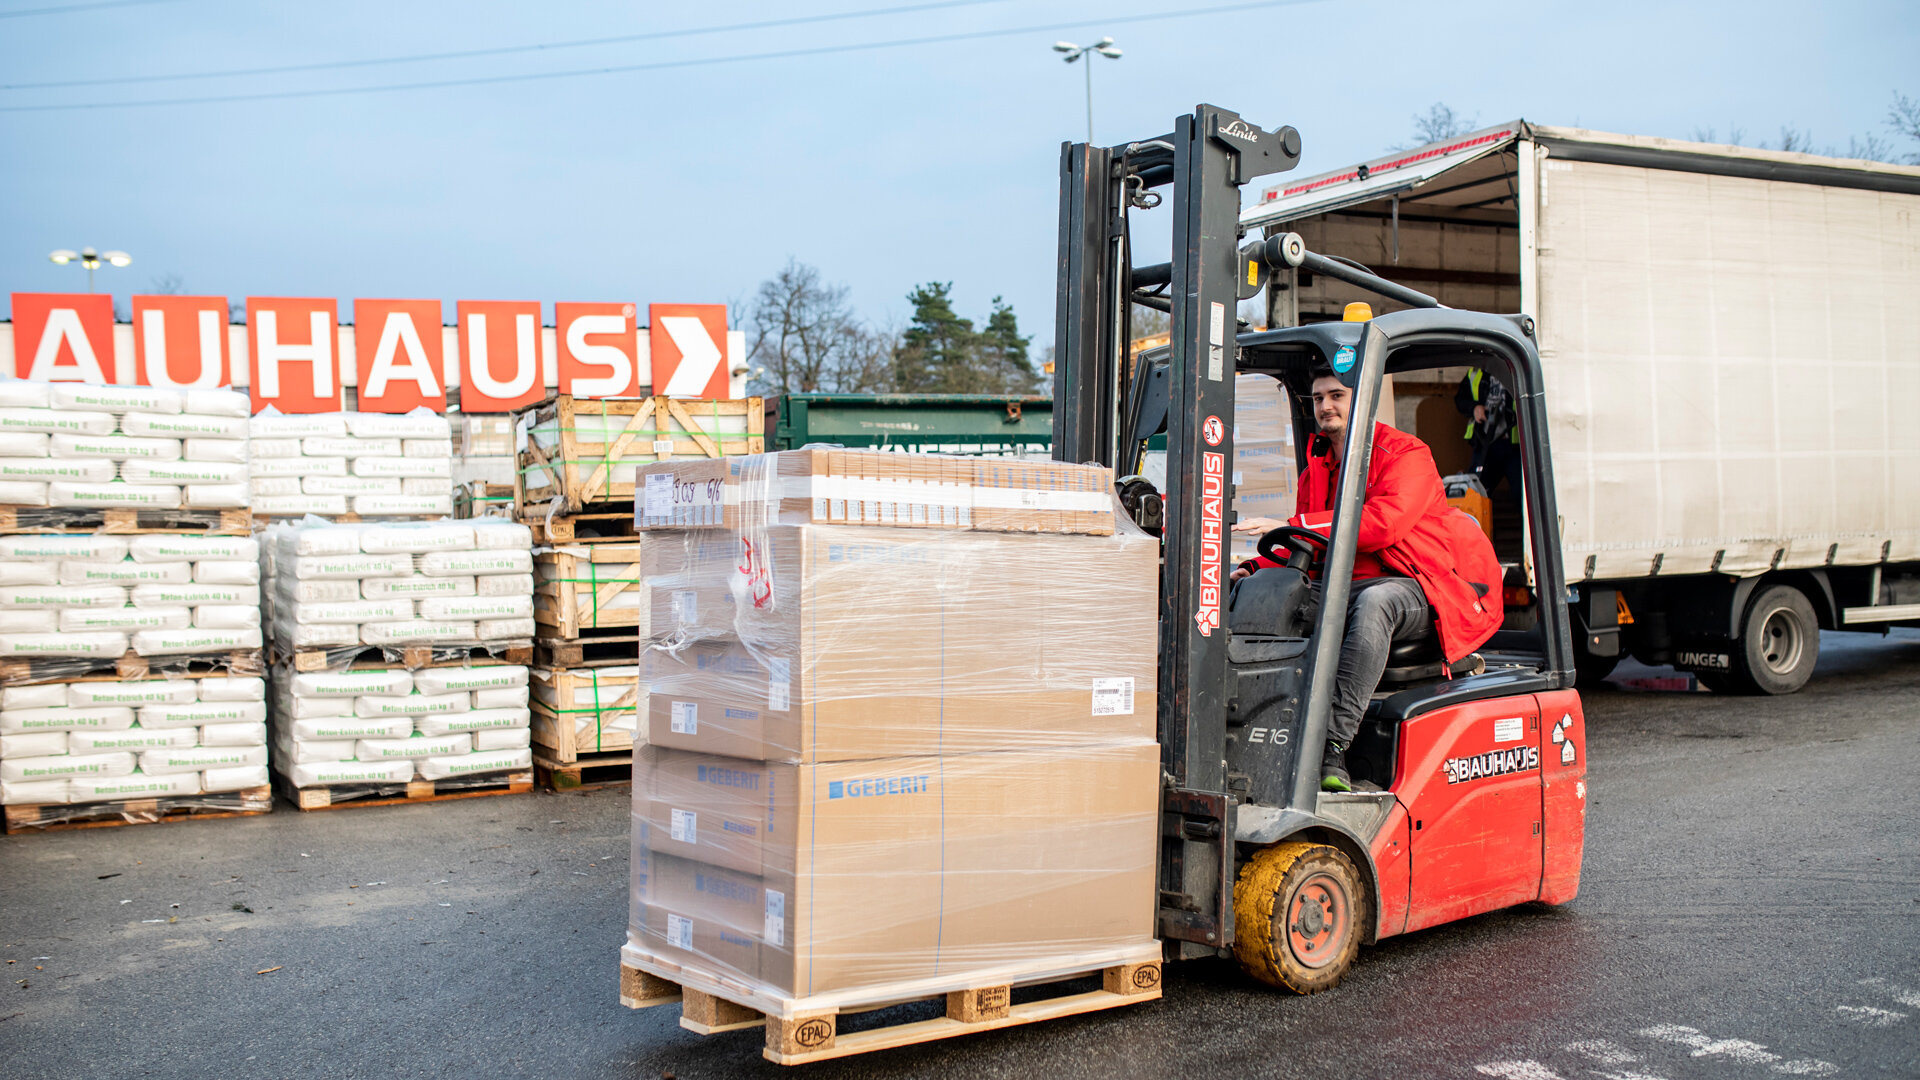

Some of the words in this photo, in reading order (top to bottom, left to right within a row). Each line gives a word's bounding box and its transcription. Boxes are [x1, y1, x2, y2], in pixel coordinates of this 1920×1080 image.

[1218, 120, 1258, 143] Linde
[76, 396, 126, 406] Beton-Estrich
[143, 400, 150, 408] kg
[2, 418, 55, 427] Beton-Estrich
[70, 421, 78, 429] kg
[149, 423, 198, 432] Beton-Estrich
[212, 426, 221, 434] kg
[75, 444, 125, 454] Beton-Estrich
[140, 448, 149, 456] kg
[3, 467, 55, 475] Beton-Estrich
[70, 469, 79, 477] kg
[150, 470, 198, 479] Beton-Estrich
[212, 473, 221, 481] kg
[74, 492, 125, 500] Beton-Estrich
[139, 494, 148, 502] kg
[1202, 455, 1223, 605] BAUHAUS
[81, 549, 90, 557] kg
[221, 548, 230, 556] kg
[86, 571, 137, 579] Beton-Estrich
[150, 571, 159, 579] kg
[15, 596, 68, 604] Beton-Estrich
[82, 597, 91, 605] kg
[161, 593, 210, 601] Beton-Estrich
[223, 593, 232, 601] kg
[150, 617, 158, 625] kg
[14, 644, 67, 652] Beton-Estrich
[82, 644, 91, 652] kg
[162, 639, 211, 648] Beton-Estrich
[224, 638, 233, 646] kg
[377, 685, 385, 693] kg
[446, 681, 490, 689] Beton-Estrich
[501, 678, 508, 686] kg
[92, 694, 143, 702] Beton-Estrich
[146, 693, 154, 701] 40
[156, 693, 165, 702] kg
[167, 713, 216, 721] Beton-Estrich
[218, 711, 226, 719] 40
[228, 711, 237, 720] kg
[22, 719, 74, 727] Beton-Estrich
[77, 718, 86, 726] 40
[89, 718, 98, 727] kg
[449, 721, 492, 730] Beton-Estrich
[494, 719, 502, 727] 40
[502, 719, 510, 727] kg
[377, 727, 385, 736] kg
[1247, 727, 1267, 743] E
[1269, 728, 1289, 745] 16
[93, 739, 143, 748] Beton-Estrich
[157, 738, 166, 747] kg
[383, 748, 428, 756] Beton-Estrich
[440, 746, 448, 754] kg
[168, 758, 217, 766] Beton-Estrich
[230, 755, 239, 764] kg
[1458, 747, 1539, 781] BAUHAUS
[24, 767, 75, 776] Beton-Estrich
[78, 765, 87, 773] 40
[89, 765, 99, 774] kg
[450, 763, 493, 773] Beton-Estrich
[495, 761, 503, 769] 40
[504, 760, 512, 768] kg
[318, 773, 365, 781] Beton-Estrich
[378, 772, 386, 780] kg
[708, 767, 760, 791] GEBERIT
[95, 784, 146, 794] Beton-Estrich
[148, 783, 157, 791] 40
[159, 783, 168, 792] kg
[847, 775, 929, 798] GEBERIT
[706, 877, 758, 905] GEBERIT
[1137, 969, 1158, 985] EPAL
[800, 1022, 828, 1042] EPAL
